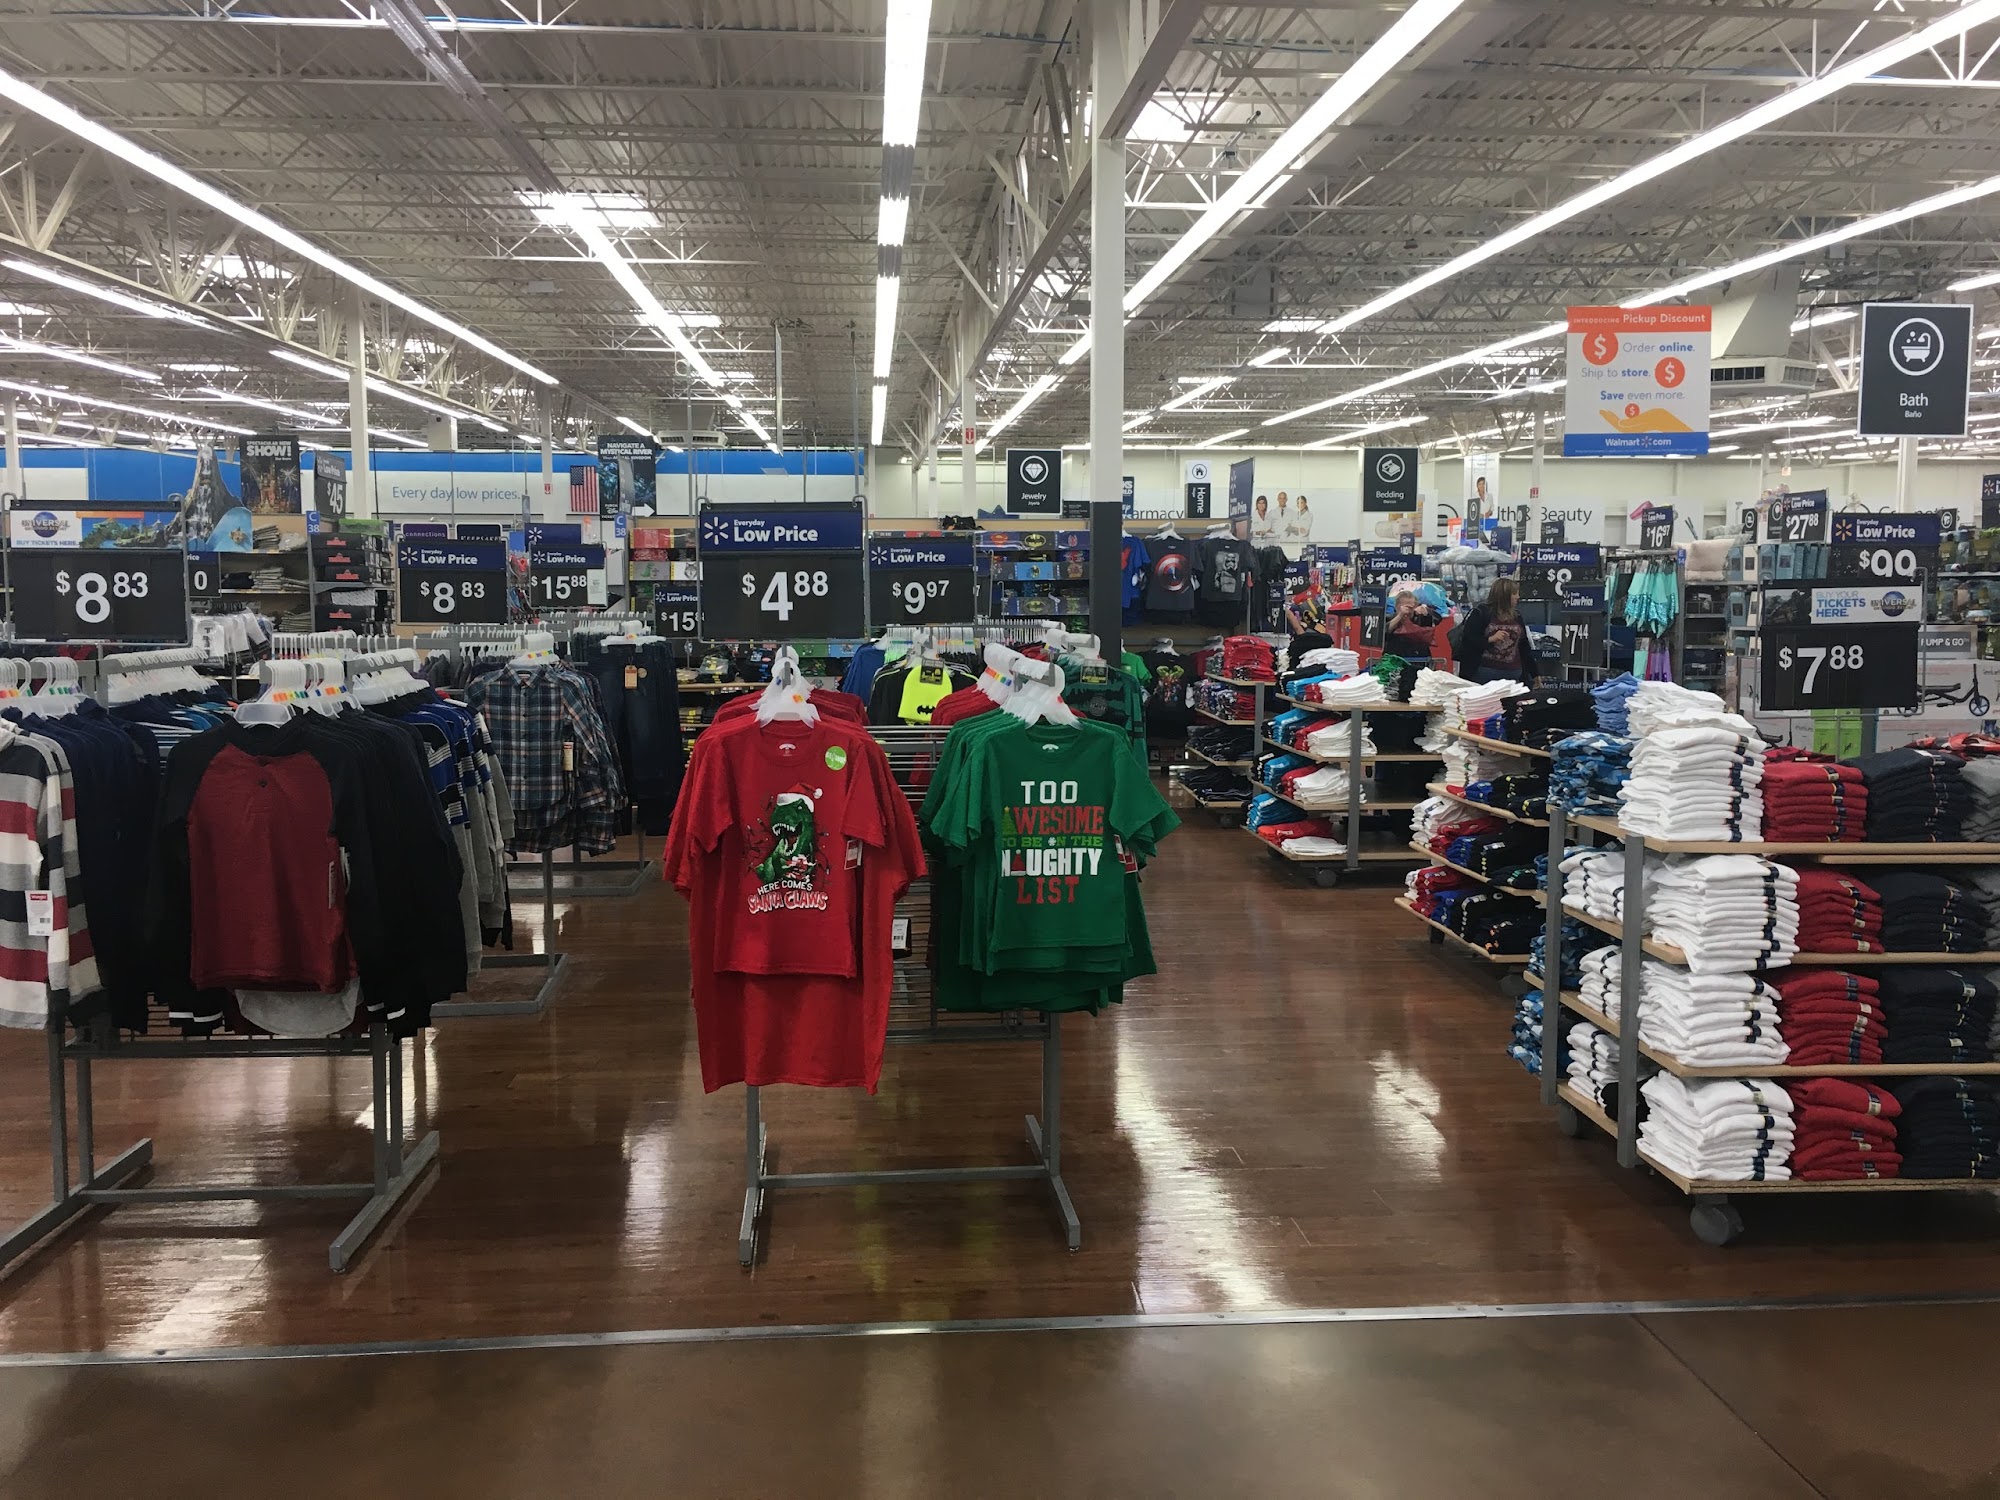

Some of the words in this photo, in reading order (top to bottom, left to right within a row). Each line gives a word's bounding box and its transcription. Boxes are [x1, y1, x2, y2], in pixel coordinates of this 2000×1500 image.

[1623, 314, 1657, 325] Pickup
[1660, 313, 1706, 323] Discount
[1622, 342, 1656, 353] Order
[1659, 342, 1696, 352] online.
[1581, 368, 1604, 380] Ship
[1607, 368, 1618, 377] to
[1621, 368, 1652, 377] store.
[1600, 391, 1625, 400] Save
[1627, 392, 1652, 400] even
[1655, 391, 1686, 400] more.
[1899, 393, 1929, 407] Bath
[1904, 410, 1922, 419] Baño
[1605, 438, 1641, 447] Walmart
[1652, 438, 1672, 447] com
[246, 445, 292, 457] SHOW!
[392, 486, 428, 502] Every
[430, 486, 453, 502] day
[454, 487, 479, 500] low
[481, 487, 520, 502] prices.
[1021, 493, 1047, 501] Jewelry
[1375, 491, 1405, 499] Bedding
[1197, 487, 1206, 514] Home
[309, 512, 318, 522] C
[616, 516, 624, 525] C
[1856, 518, 1879, 526] Everyday
[308, 524, 320, 533] 38
[733, 519, 765, 528] Everyday
[615, 528, 626, 536] 38
[733, 526, 771, 542] Low
[774, 525, 818, 542] Price
[1856, 525, 1883, 538] Low
[1884, 525, 1916, 538] Price
[421, 554, 446, 564] Low
[448, 554, 478, 565] Price
[547, 555, 564, 563] Low
[565, 555, 586, 563] Price
[890, 552, 915, 563] Low
[917, 552, 946, 563] Price
[1537, 552, 1556, 561] Low
[1557, 552, 1581, 561] Price
[194, 570, 208, 591] 0
[1831, 590, 1859, 598] YOUR
[1570, 596, 1581, 606] Low
[1581, 596, 1594, 606] Price
[1816, 598, 1866, 608] TICKETS
[1815, 608, 1850, 618] HERE.
[1944, 638, 1951, 646] &
[1020, 780, 1078, 805] TOO
[1021, 836, 1043, 848] BE
[1070, 836, 1104, 847] THE
[757, 880, 780, 896] HERE
[781, 879, 814, 892] COMES
[1016, 876, 1080, 905] LIST
[747, 890, 784, 914] SANTA
[784, 889, 829, 910] CLAWS
